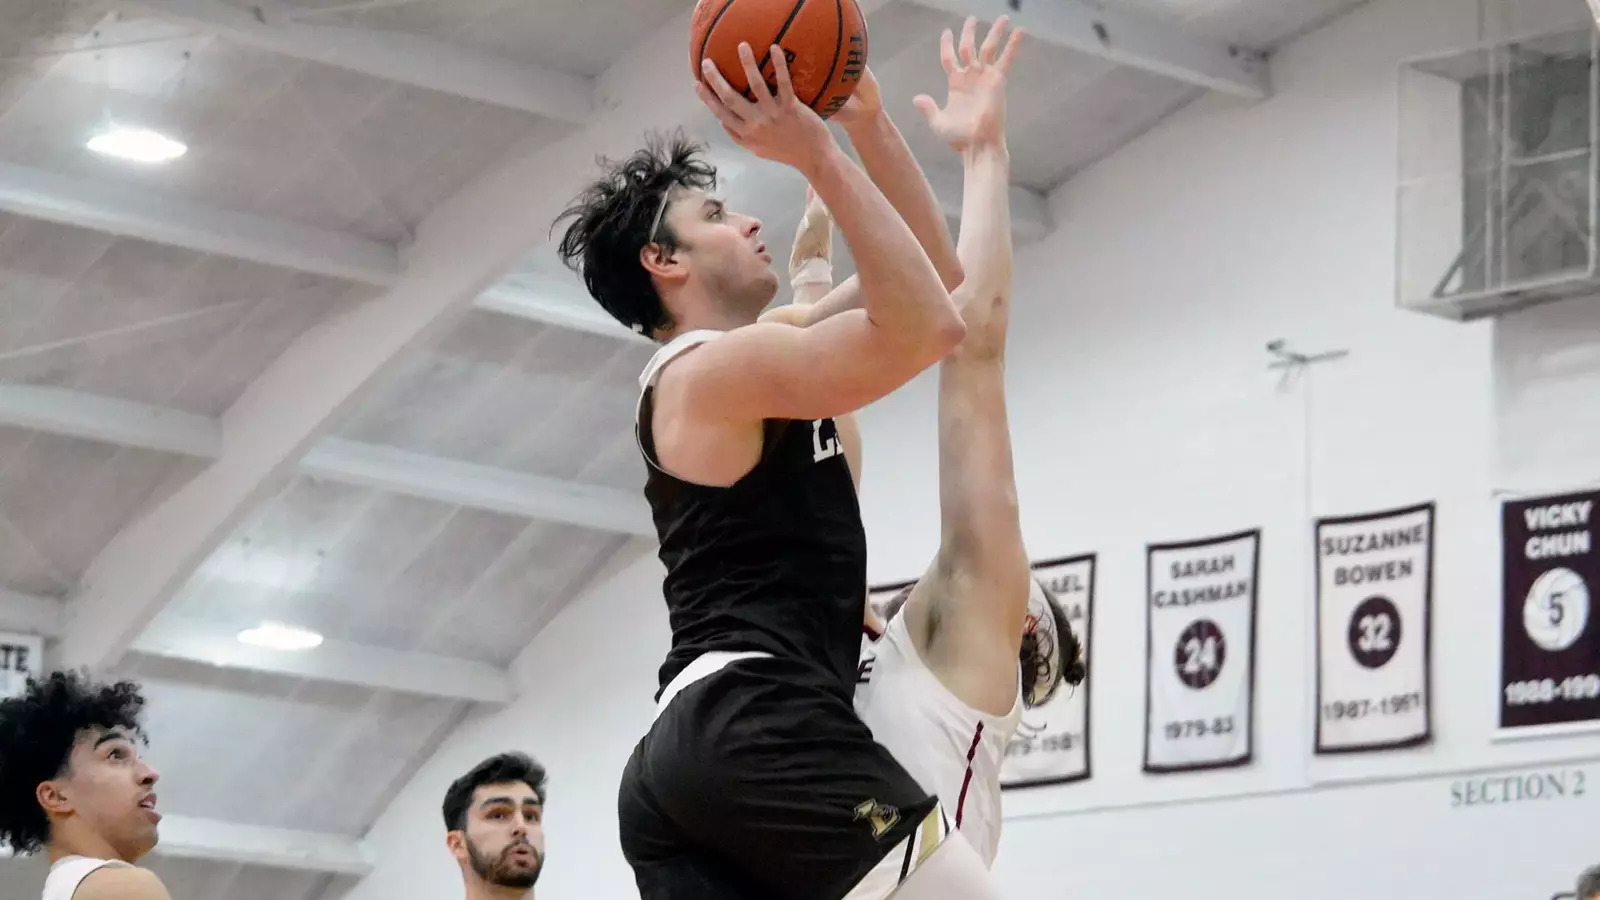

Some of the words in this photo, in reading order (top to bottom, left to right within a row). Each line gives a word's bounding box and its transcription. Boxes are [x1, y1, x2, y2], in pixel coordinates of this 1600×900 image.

[842, 33, 863, 82] THE
[813, 418, 844, 462] L
[1524, 502, 1591, 530] VICKY
[1322, 524, 1424, 555] SUZANNE
[1525, 531, 1590, 559] CHUN
[1170, 556, 1235, 579] SARAH
[1334, 559, 1413, 586] BOWEN
[1155, 582, 1248, 608] CASHMAN
[1549, 593, 1564, 626] 5
[1358, 612, 1394, 652] 32
[1184, 636, 1216, 674] 24
[1165, 716, 1235, 741] 1979-83
[1450, 772, 1566, 808] SECTION
[1572, 769, 1586, 797] 2
